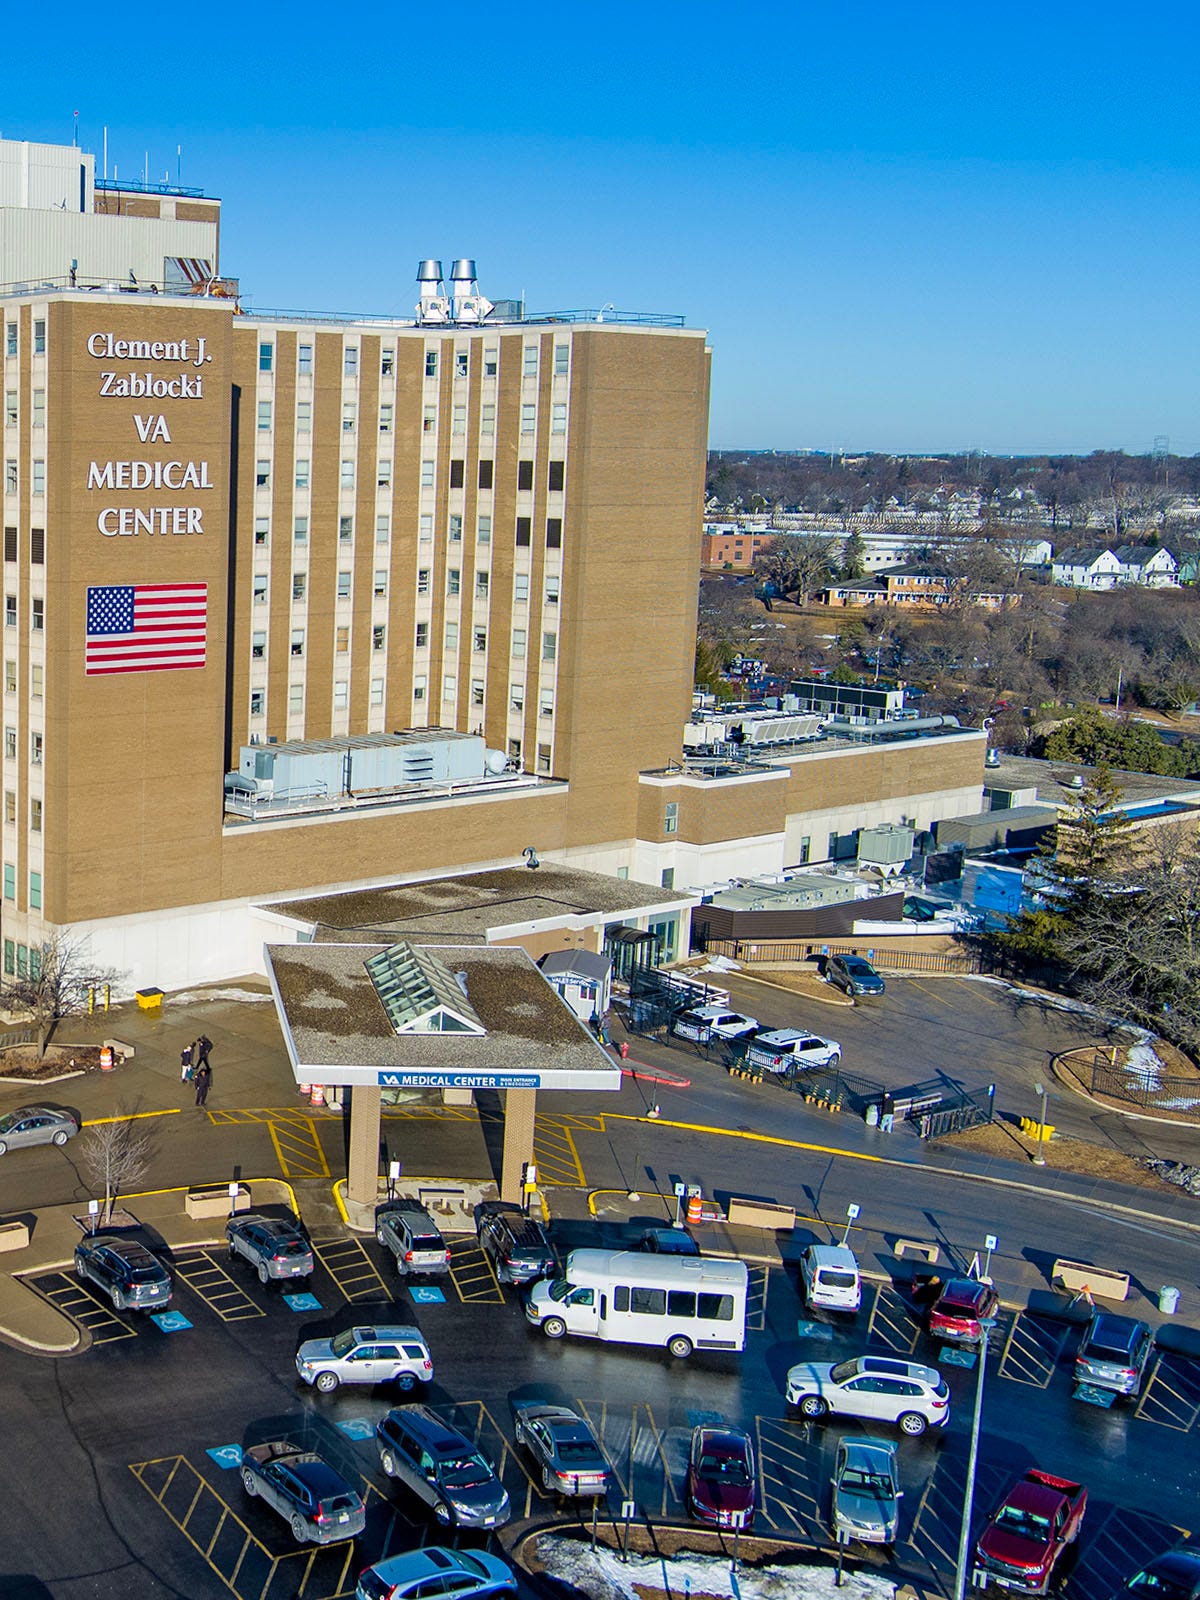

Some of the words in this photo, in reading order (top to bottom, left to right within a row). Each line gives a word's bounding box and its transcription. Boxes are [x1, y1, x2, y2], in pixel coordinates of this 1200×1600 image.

[87, 333, 190, 362] Clement
[193, 337, 213, 367] J.
[99, 372, 203, 399] Zablocki
[132, 414, 171, 443] VA
[87, 461, 214, 490] MEDICAL
[98, 507, 204, 536] CENTER
[382, 1074, 400, 1084] VA
[402, 1075, 450, 1086] MEDICAL
[453, 1076, 496, 1087] CENTER
